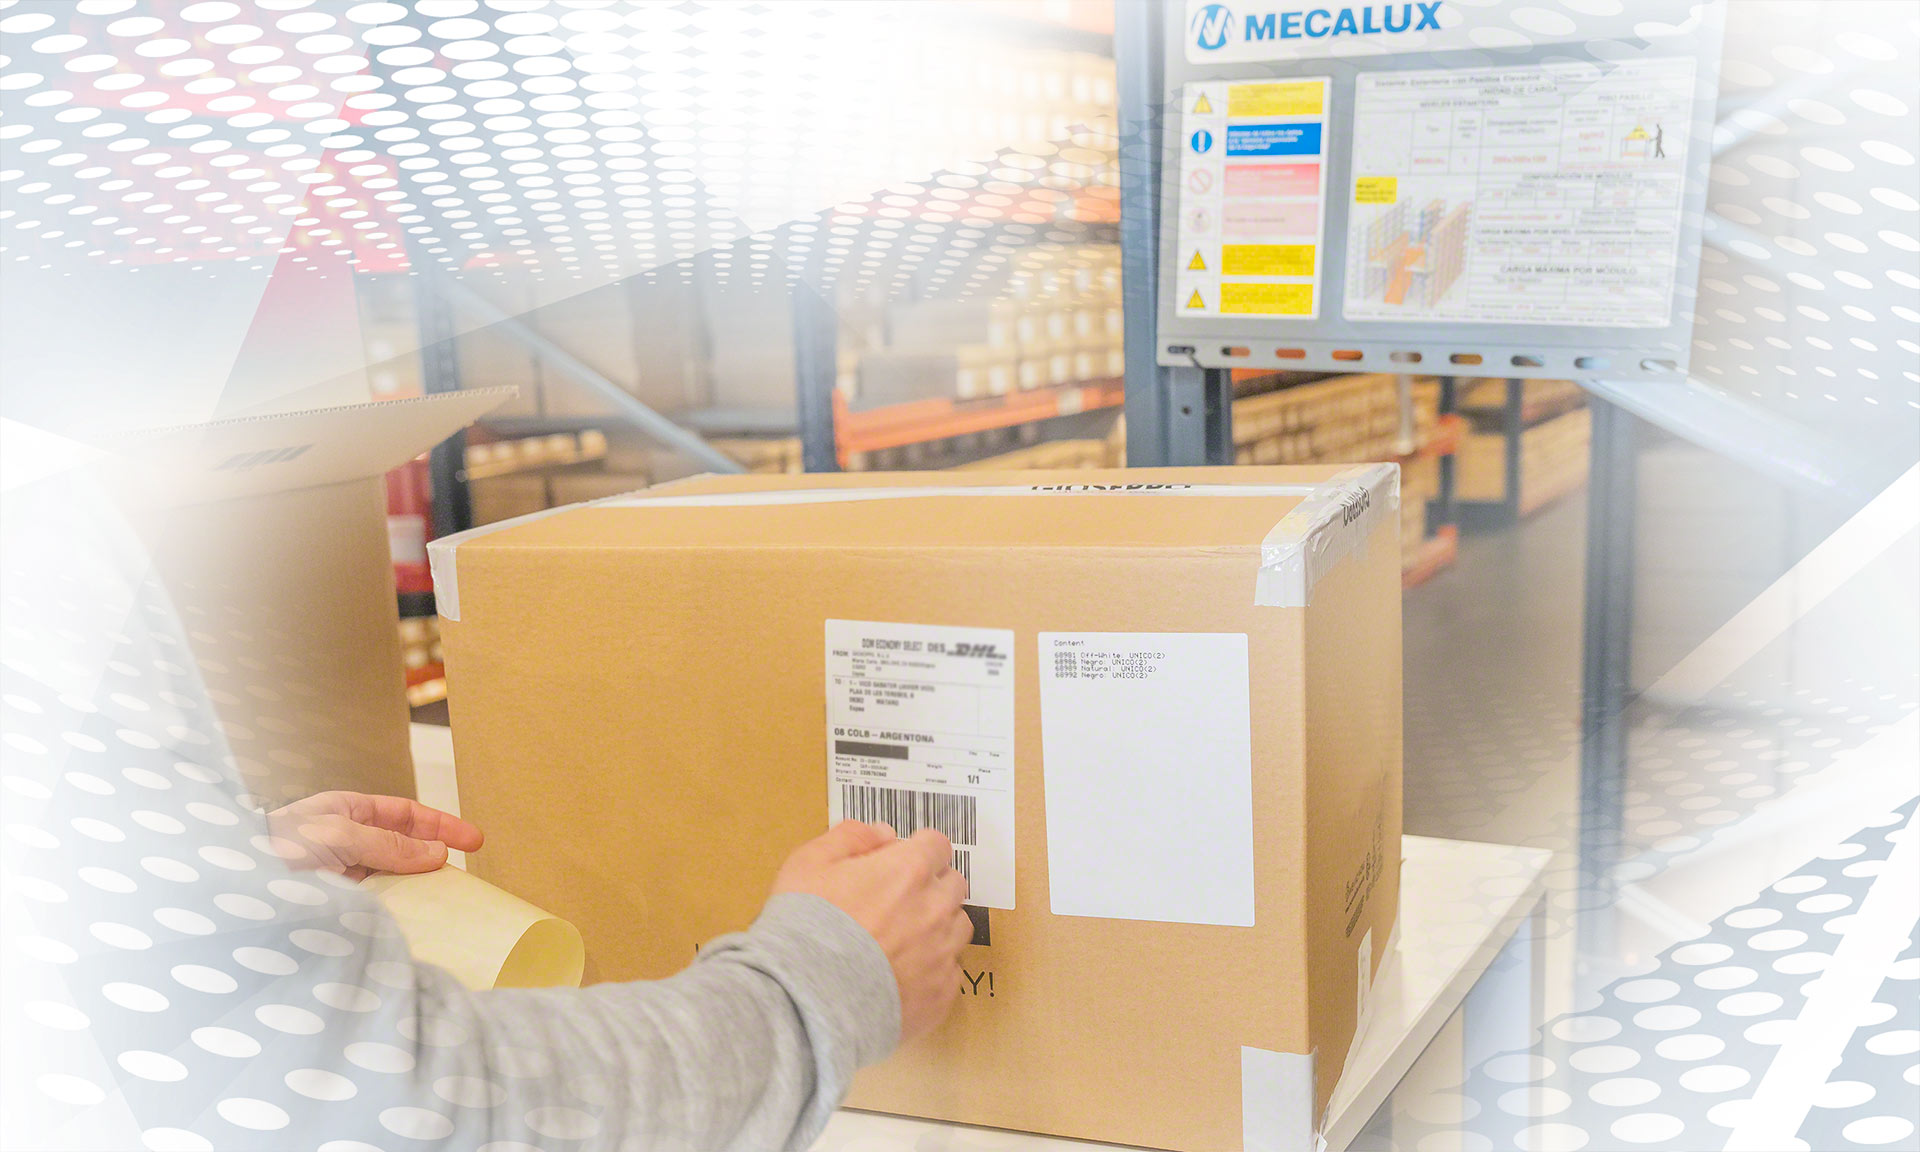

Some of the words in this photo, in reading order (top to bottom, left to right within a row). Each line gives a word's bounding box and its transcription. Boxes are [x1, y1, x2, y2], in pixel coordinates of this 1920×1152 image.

[1245, 2, 1442, 41] MECALUX
[876, 639, 902, 650] ECONOMY
[903, 640, 923, 651] SELECT
[951, 643, 1003, 659] DHL
[834, 728, 845, 736] 08
[847, 729, 870, 738] COLB
[879, 731, 935, 743] ARGENTONA
[967, 775, 980, 785] 1/1
[960, 969, 995, 998] Y!
